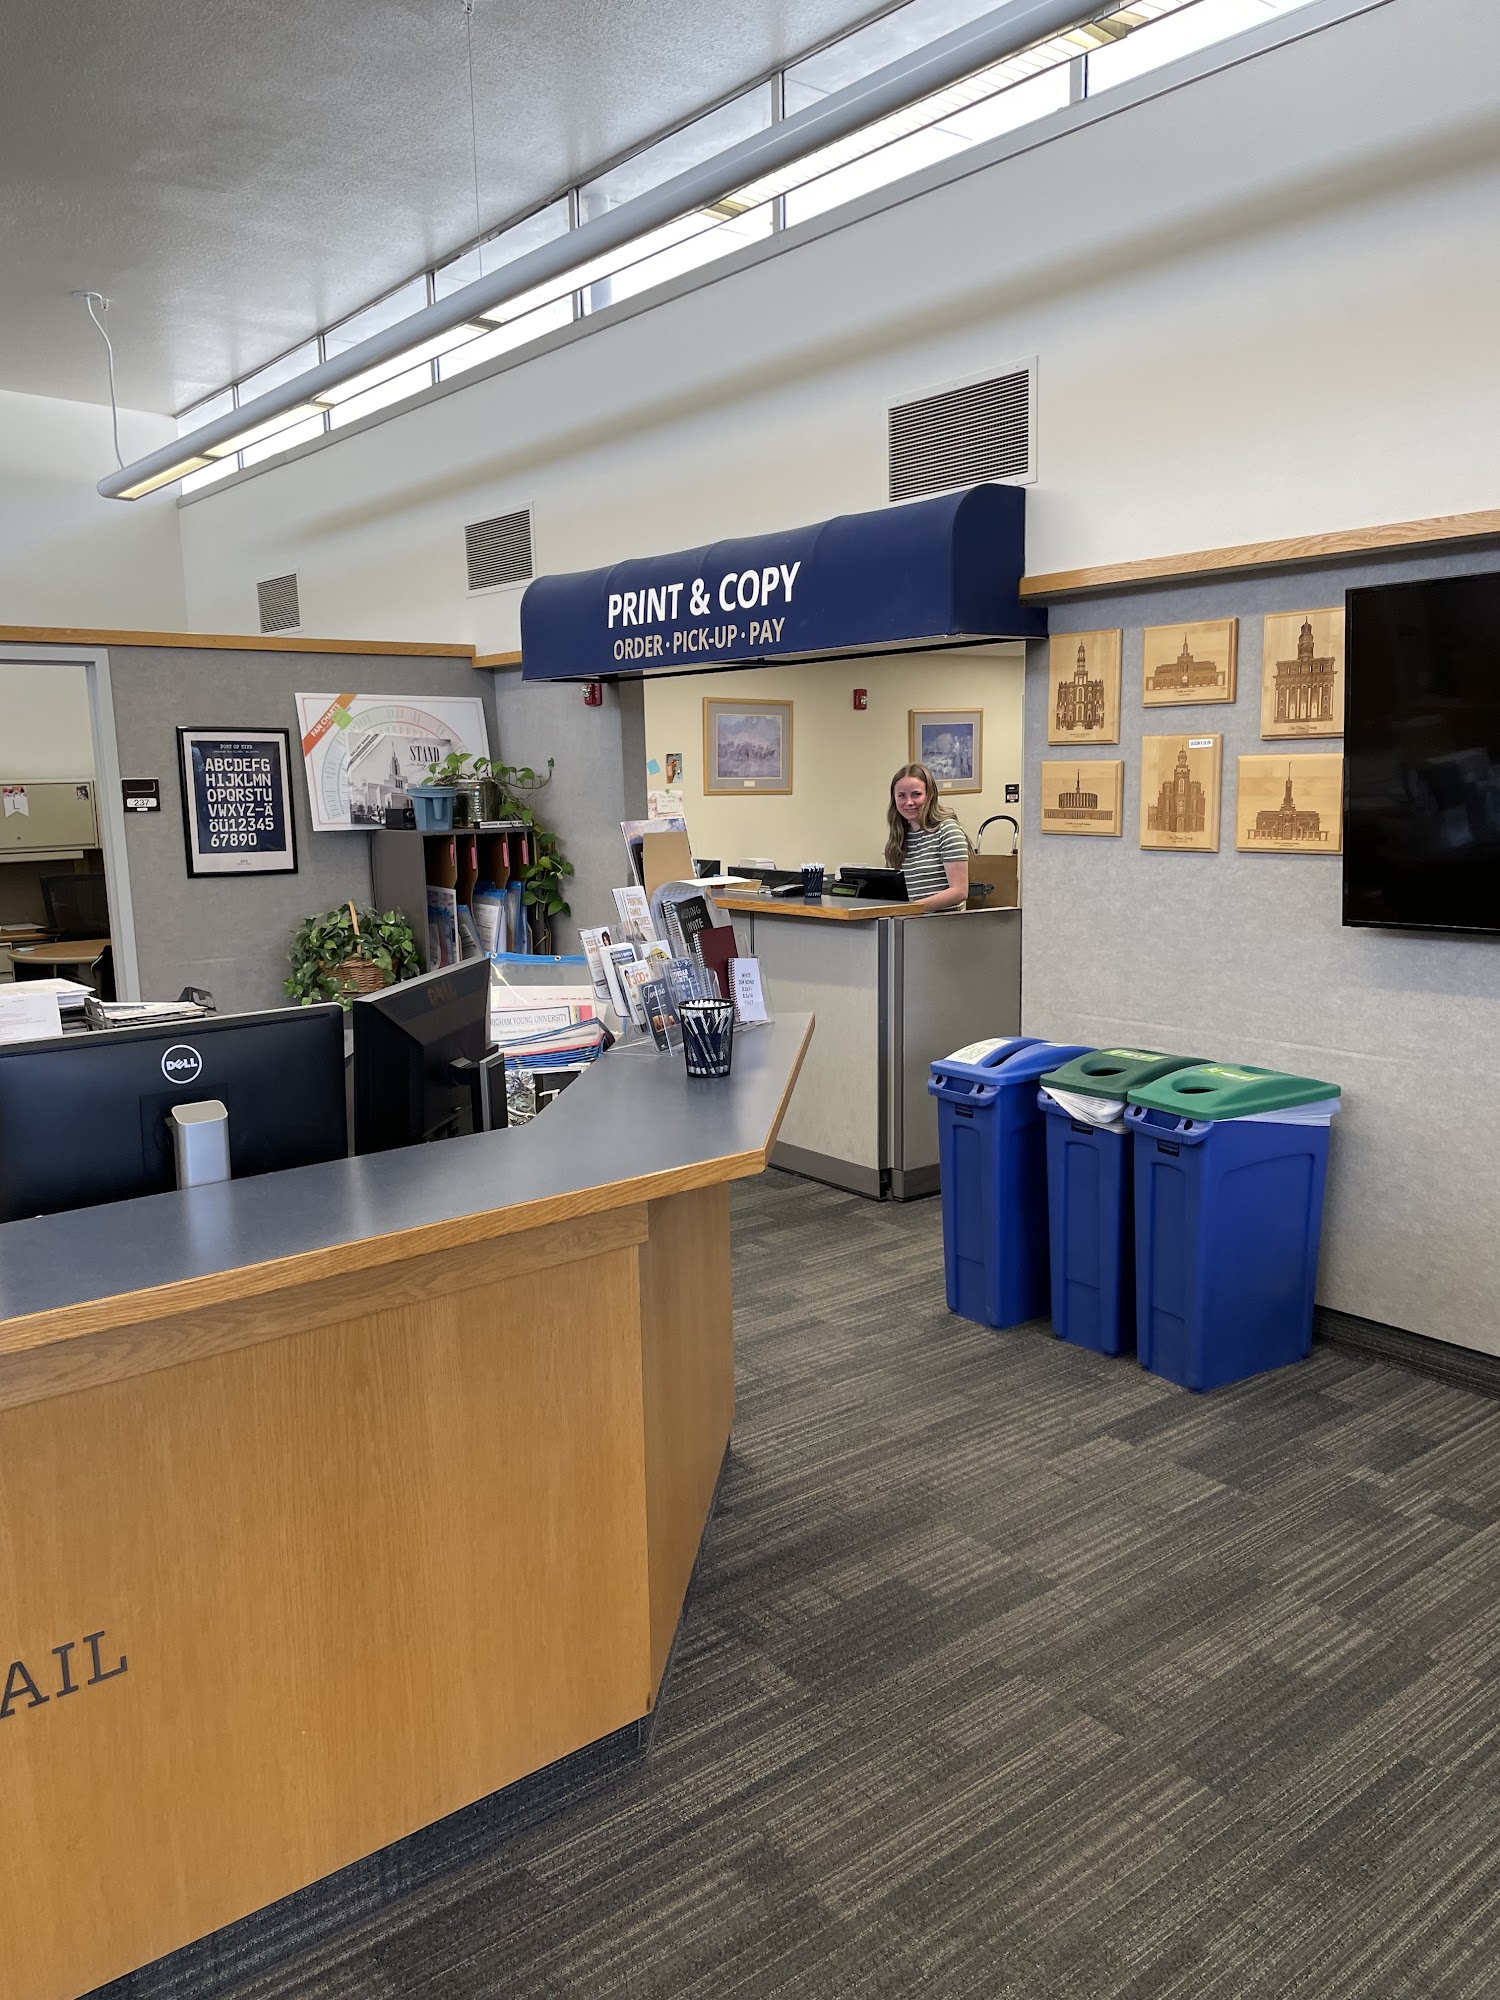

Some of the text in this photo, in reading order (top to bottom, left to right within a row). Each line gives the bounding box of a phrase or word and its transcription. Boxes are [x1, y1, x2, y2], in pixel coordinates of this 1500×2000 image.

[607, 561, 802, 629] PRINT & COPY
[613, 616, 786, 660] ORDER PICK-UP PAY
[310, 724, 323, 737] FAN
[320, 702, 340, 725] CHARTS
[410, 745, 440, 762] STAND
[205, 758, 271, 772] ABCDEFG
[205, 773, 271, 787] HIJKLMN
[207, 788, 272, 802] OPQRSTU
[210, 832, 257, 847] 67890
[491, 1013, 567, 1026] RIGHAM YOUNG UNIVERSITY
[166, 1057, 198, 1071] DELL
[0, 1630, 128, 1719] AIL
